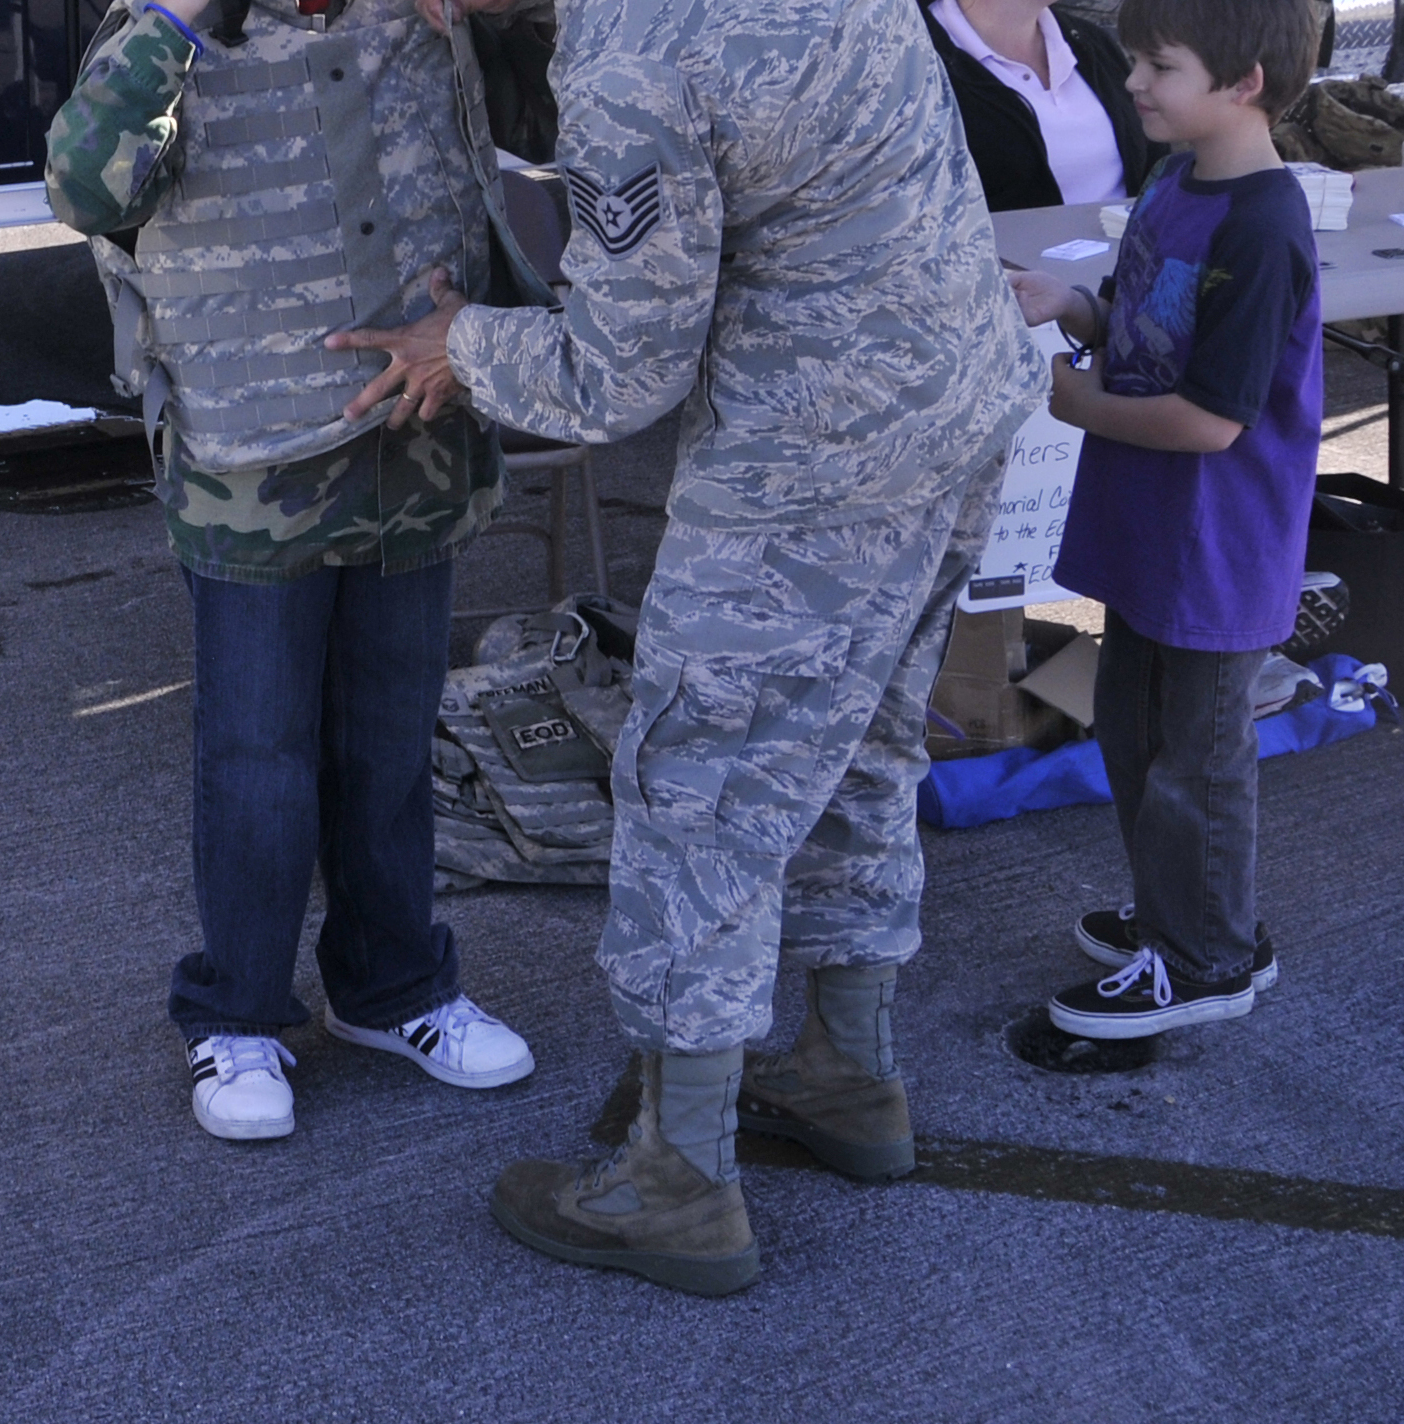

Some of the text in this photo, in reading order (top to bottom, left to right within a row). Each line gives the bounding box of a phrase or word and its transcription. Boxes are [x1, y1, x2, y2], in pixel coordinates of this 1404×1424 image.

[993, 525, 1009, 542] to
[1015, 522, 1037, 539] the
[520, 722, 569, 744] EOD
